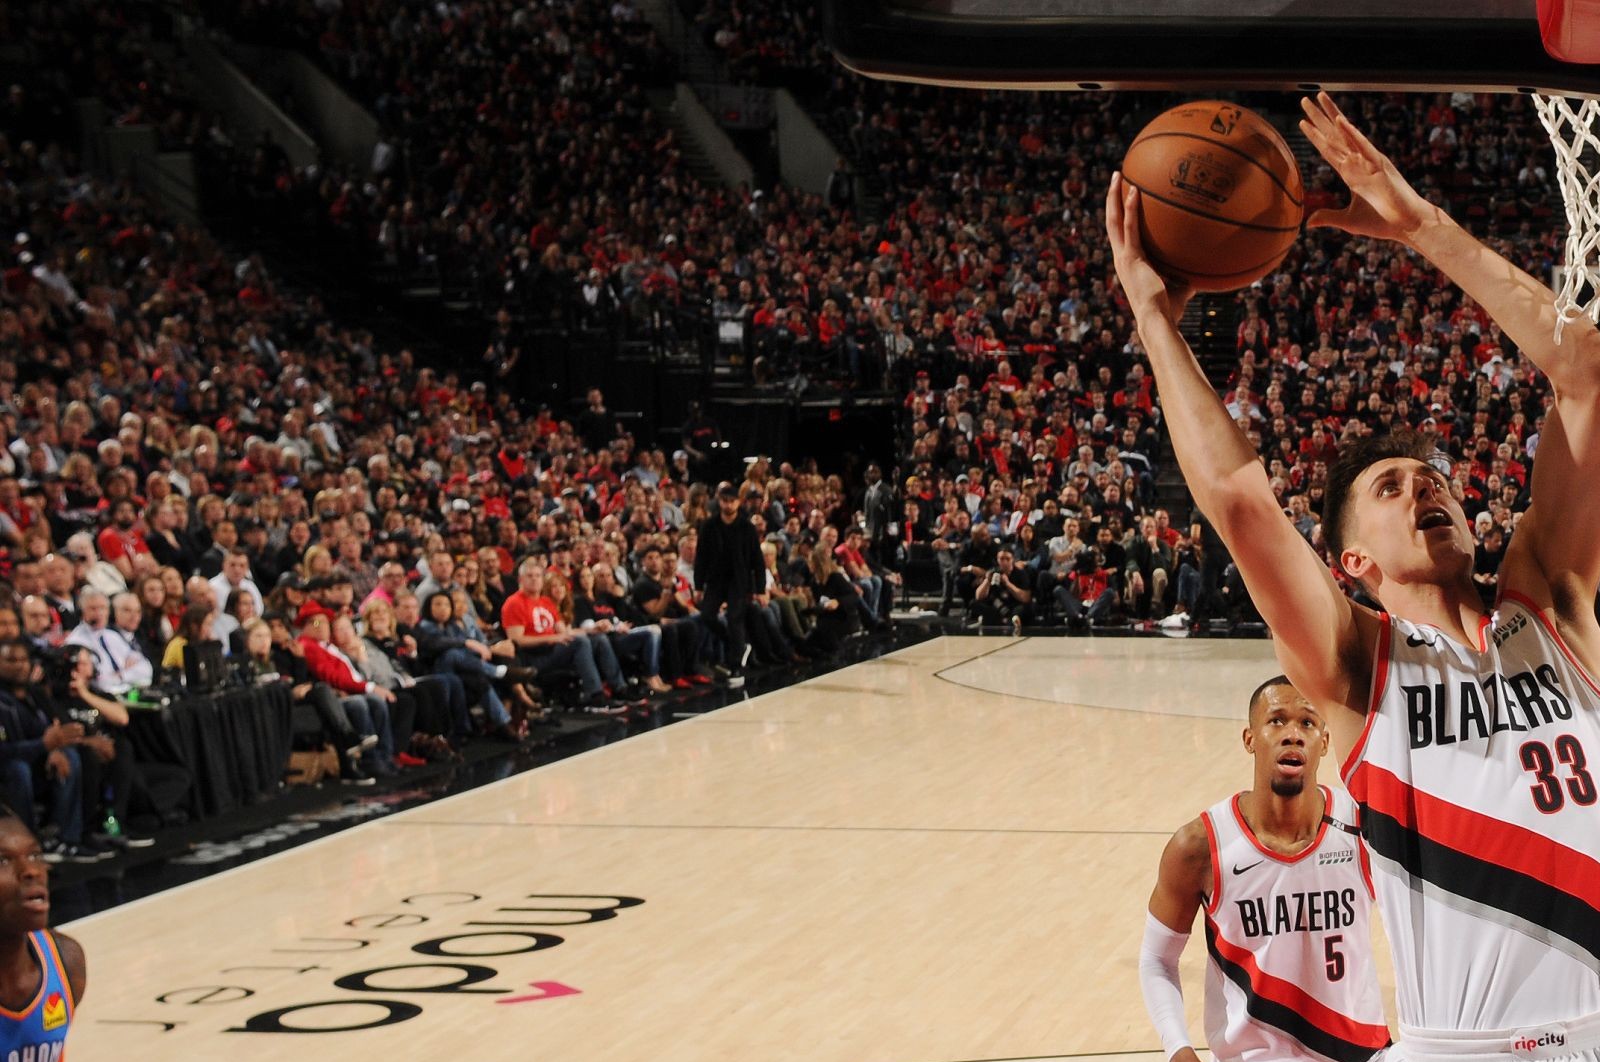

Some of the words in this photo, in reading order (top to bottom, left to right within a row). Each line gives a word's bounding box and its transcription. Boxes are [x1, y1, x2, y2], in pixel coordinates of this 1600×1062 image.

[1401, 663, 1573, 750] BLAZERS
[1518, 733, 1598, 815] 33
[1234, 887, 1356, 938] BLAZERS
[1324, 934, 1346, 983] 5
